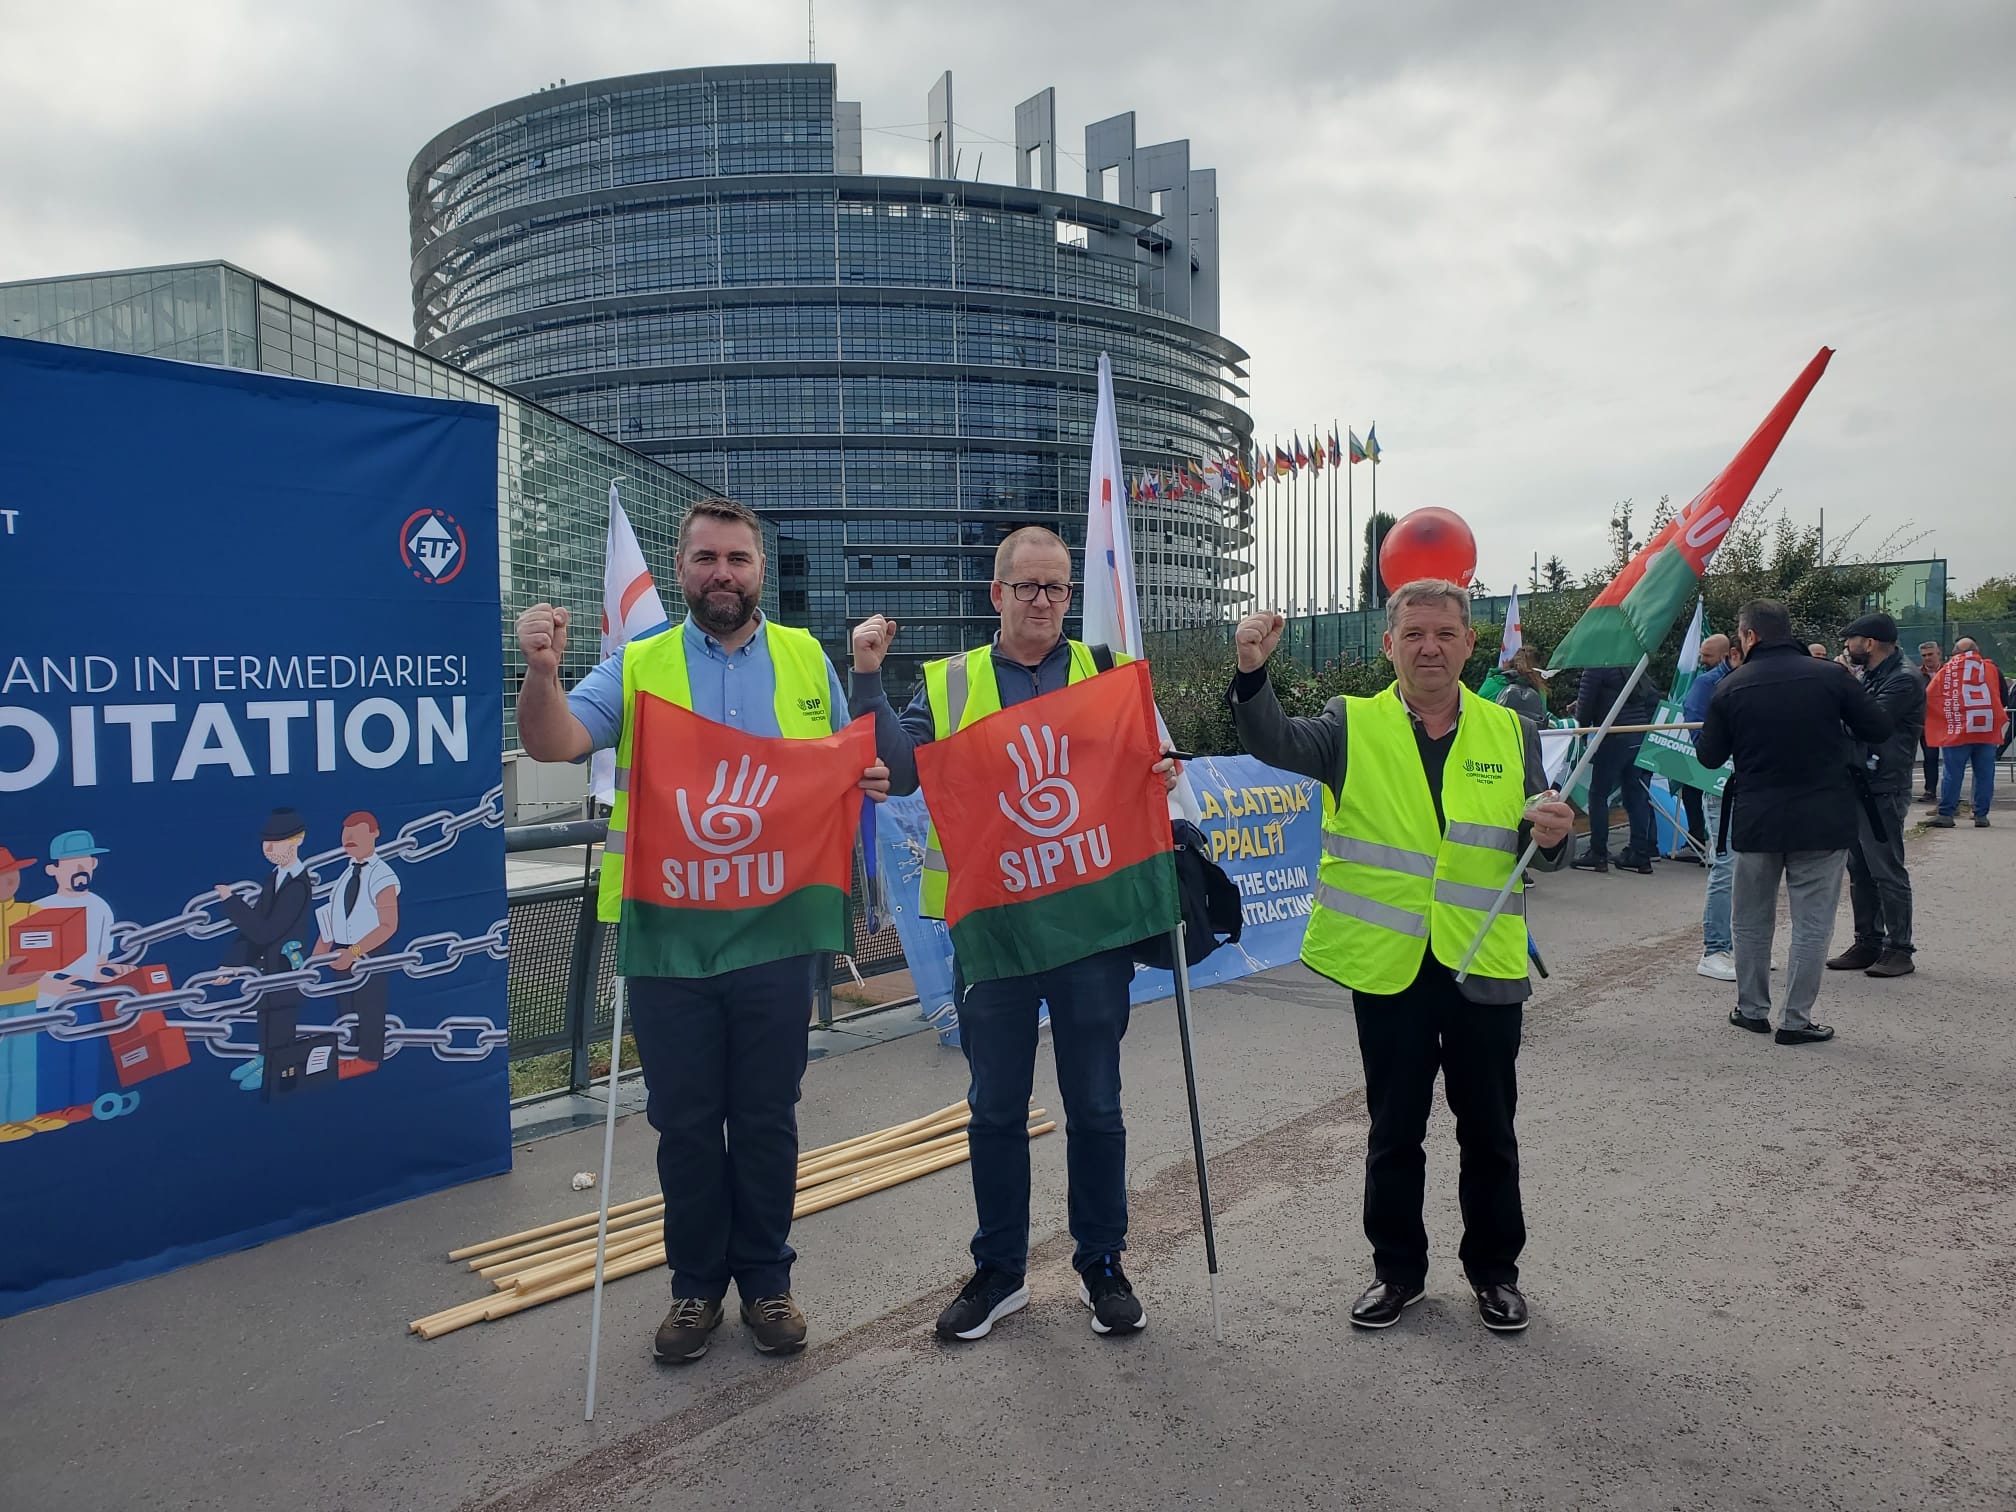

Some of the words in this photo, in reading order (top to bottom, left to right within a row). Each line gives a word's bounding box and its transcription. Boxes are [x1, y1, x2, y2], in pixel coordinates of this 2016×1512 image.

[416, 537, 453, 559] ETF
[2, 656, 118, 694] AND
[135, 655, 468, 691] INTERMEDIARIES!
[1475, 761, 1502, 773] SIPTU
[1223, 784, 1309, 817] CATENA
[1000, 823, 1112, 893] SIPTU
[1203, 823, 1284, 862] PPALTI
[662, 850, 785, 901] SIPTU
[1232, 872, 1266, 897] THE
[1265, 866, 1309, 892] CHAIN
